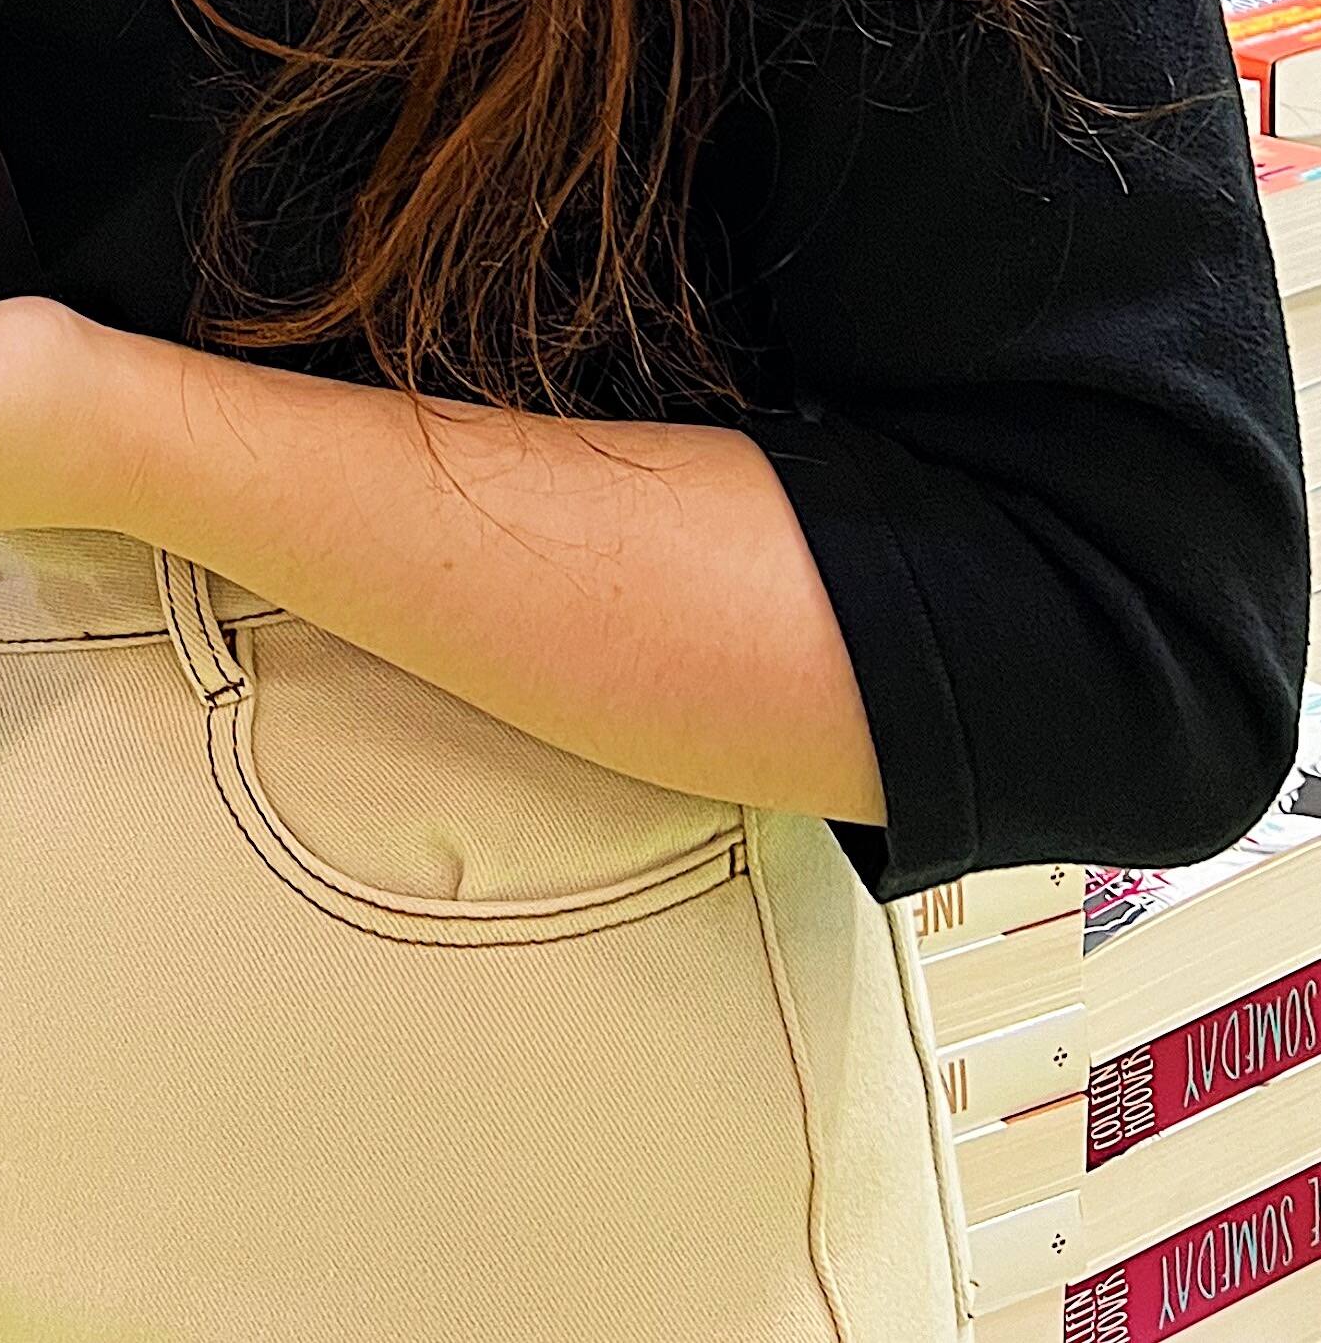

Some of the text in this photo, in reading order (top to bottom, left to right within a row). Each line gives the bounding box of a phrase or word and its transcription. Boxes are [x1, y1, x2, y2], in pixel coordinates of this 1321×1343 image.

[1182, 978, 1320, 1109] SOMEDAY
[1090, 1059, 1125, 1151] COLLEEN
[1122, 1044, 1157, 1139] HOOVER
[1095, 1268, 1129, 1343] OOVER
[1158, 1193, 1296, 1331] SOMEDAY
